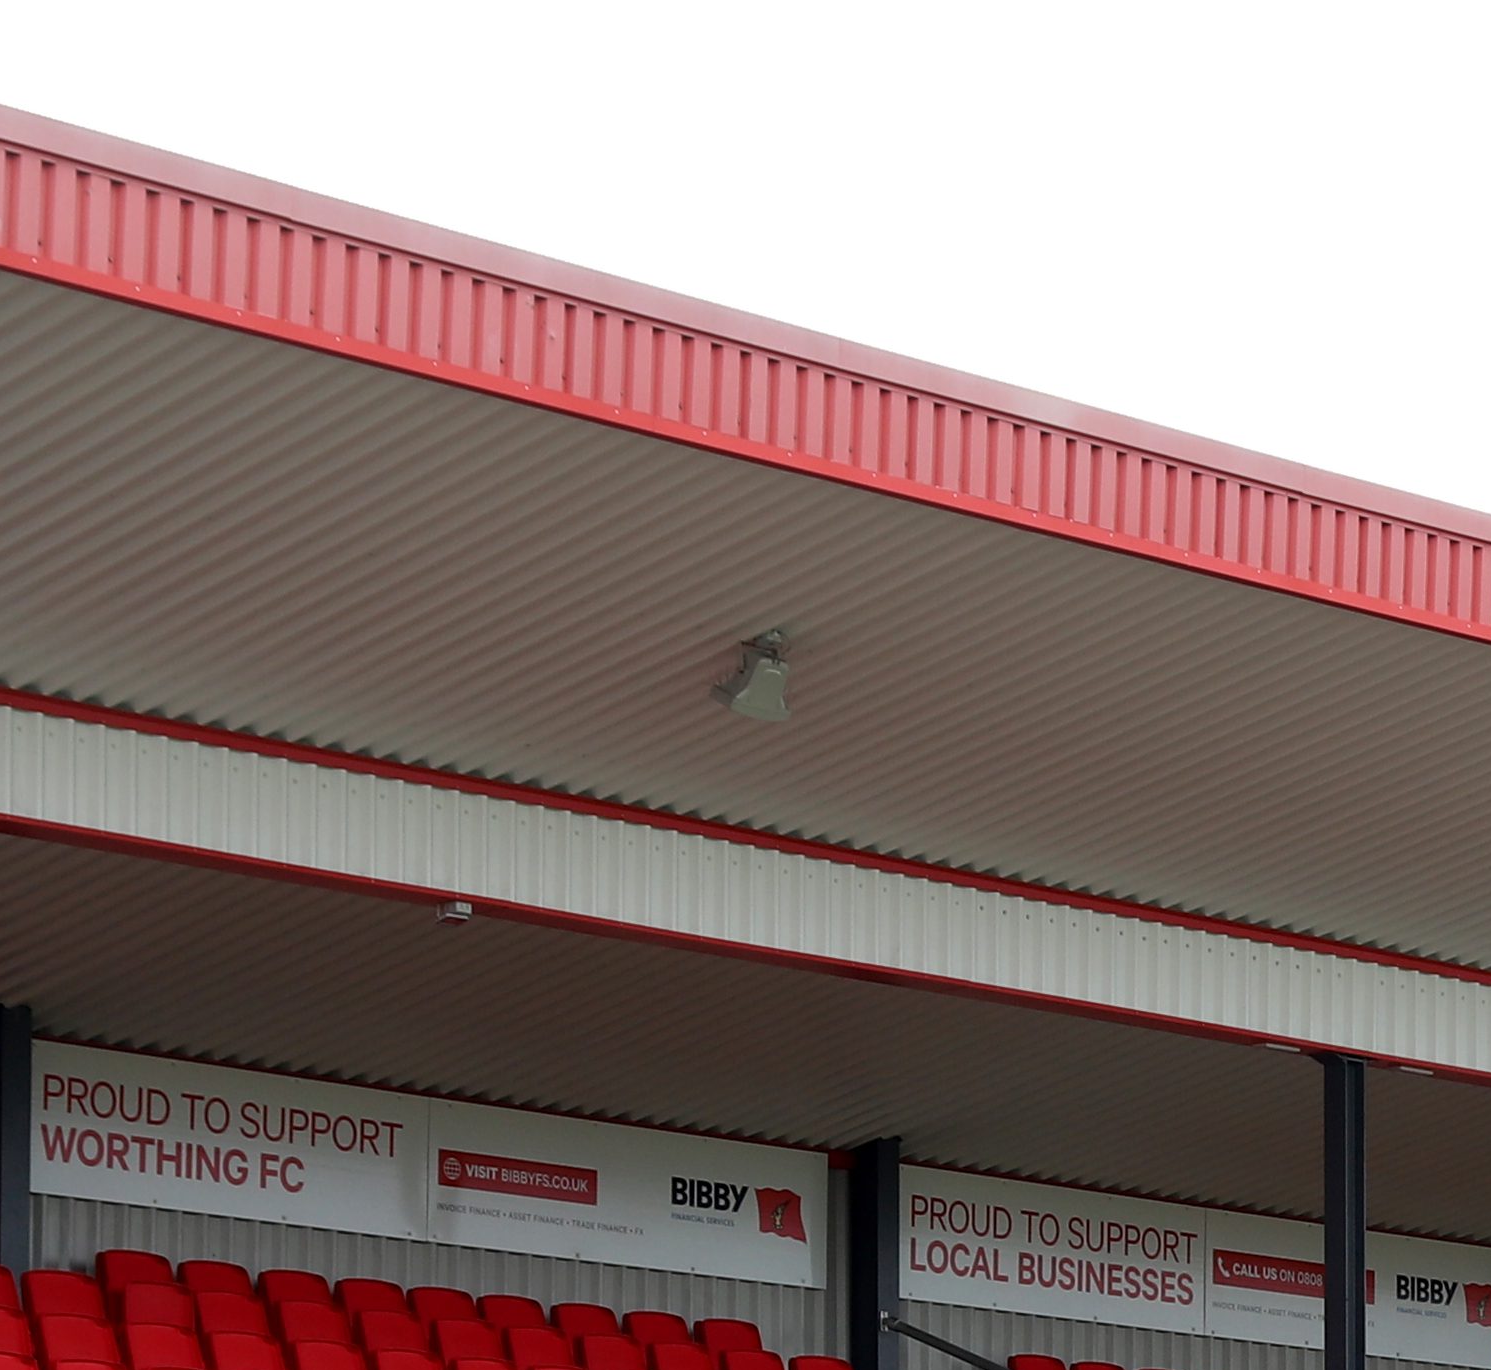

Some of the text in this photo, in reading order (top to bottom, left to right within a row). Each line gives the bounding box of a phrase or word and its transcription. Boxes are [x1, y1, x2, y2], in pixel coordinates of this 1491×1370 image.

[43, 1074, 403, 1158] PROUD TO SUPPORT
[41, 1123, 305, 1193] WORTHING FC
[465, 1163, 588, 1192] VISIT BIBBYFS.CO.UK
[671, 1176, 749, 1212] BIBBY
[911, 1194, 1197, 1264] PROUD TO SUPPORT
[910, 1238, 1193, 1306] LOCAL BUSINESSES
[1233, 1262, 1261, 1279] CALL
[1263, 1266, 1277, 1280] US
[1279, 1271, 1295, 1283] ON
[1396, 1274, 1458, 1306] BIBBY
